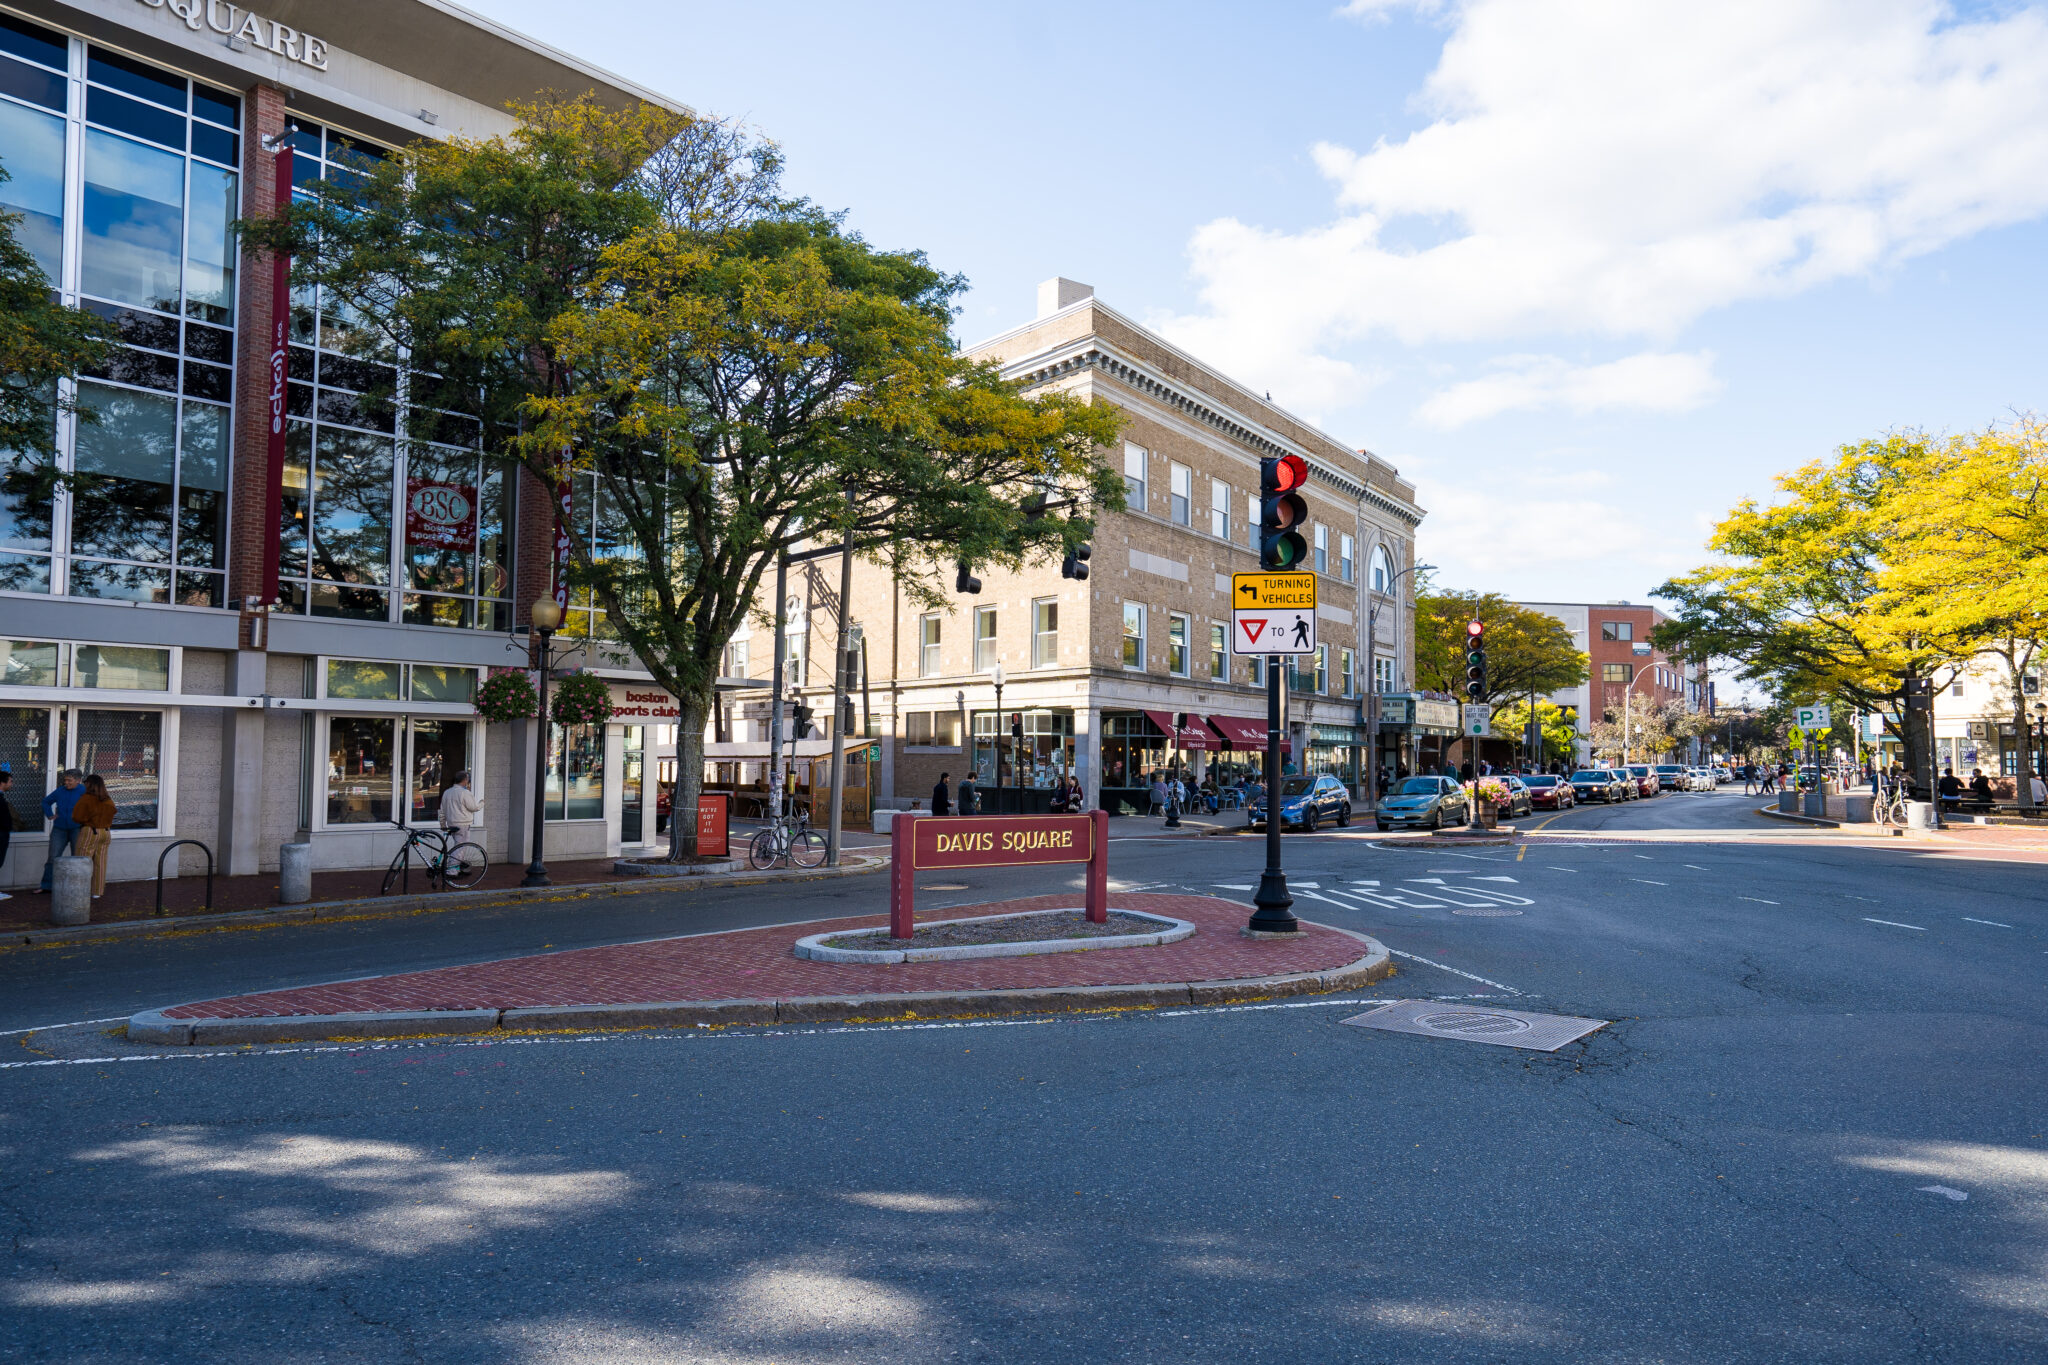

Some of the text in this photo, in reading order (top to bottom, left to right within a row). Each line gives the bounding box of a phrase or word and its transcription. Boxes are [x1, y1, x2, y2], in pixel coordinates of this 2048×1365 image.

[135, 0, 328, 72] QUARE
[420, 490, 461, 520] BSC
[1264, 579, 1311, 589] TURNING
[1262, 594, 1312, 604] VEHICLES
[1271, 627, 1285, 637] TO
[626, 691, 668, 703] boston
[611, 704, 649, 717] sports
[936, 830, 1073, 853] DAVIS SQUARE
